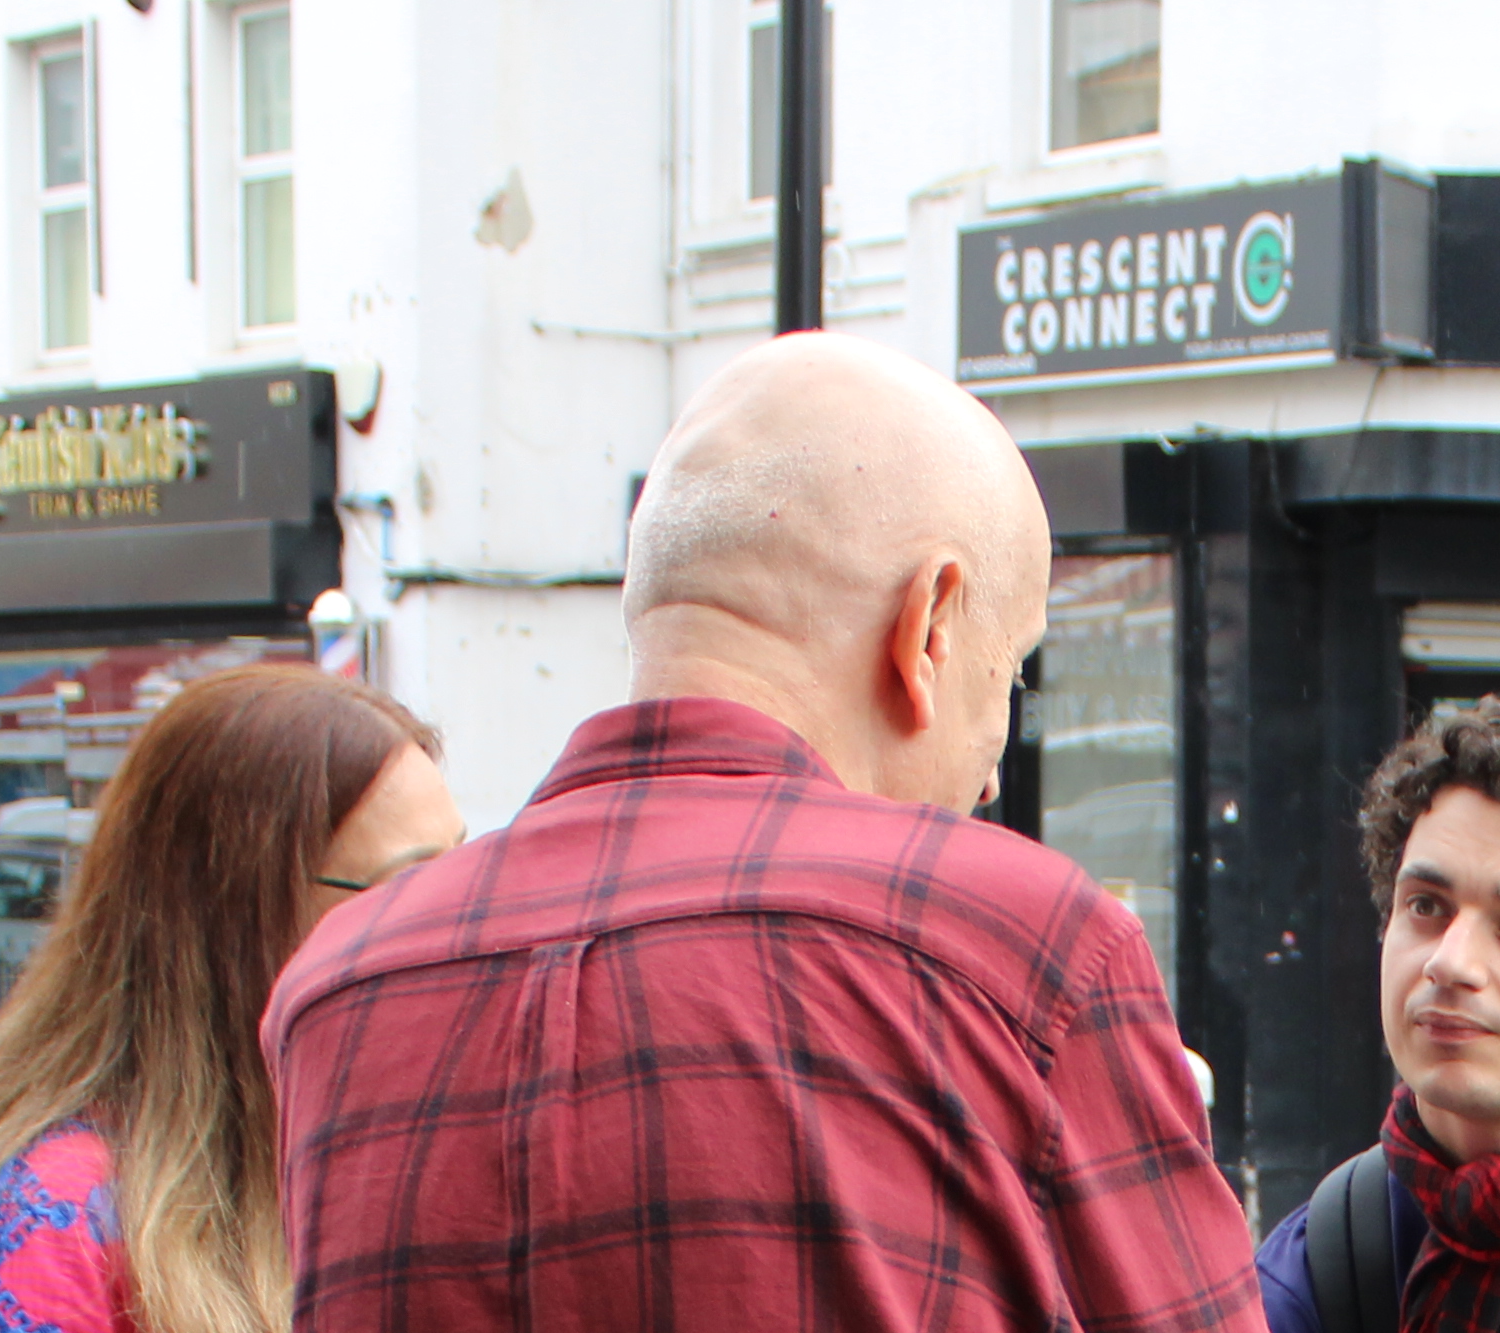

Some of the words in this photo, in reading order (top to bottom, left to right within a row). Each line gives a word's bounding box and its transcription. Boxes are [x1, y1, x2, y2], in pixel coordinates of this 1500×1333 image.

[995, 224, 1228, 304] CRESCENT
[1002, 283, 1218, 355] CONNECT
[28, 491, 71, 520] TRIM
[75, 487, 93, 520] &
[95, 484, 161, 519] SHAVE
